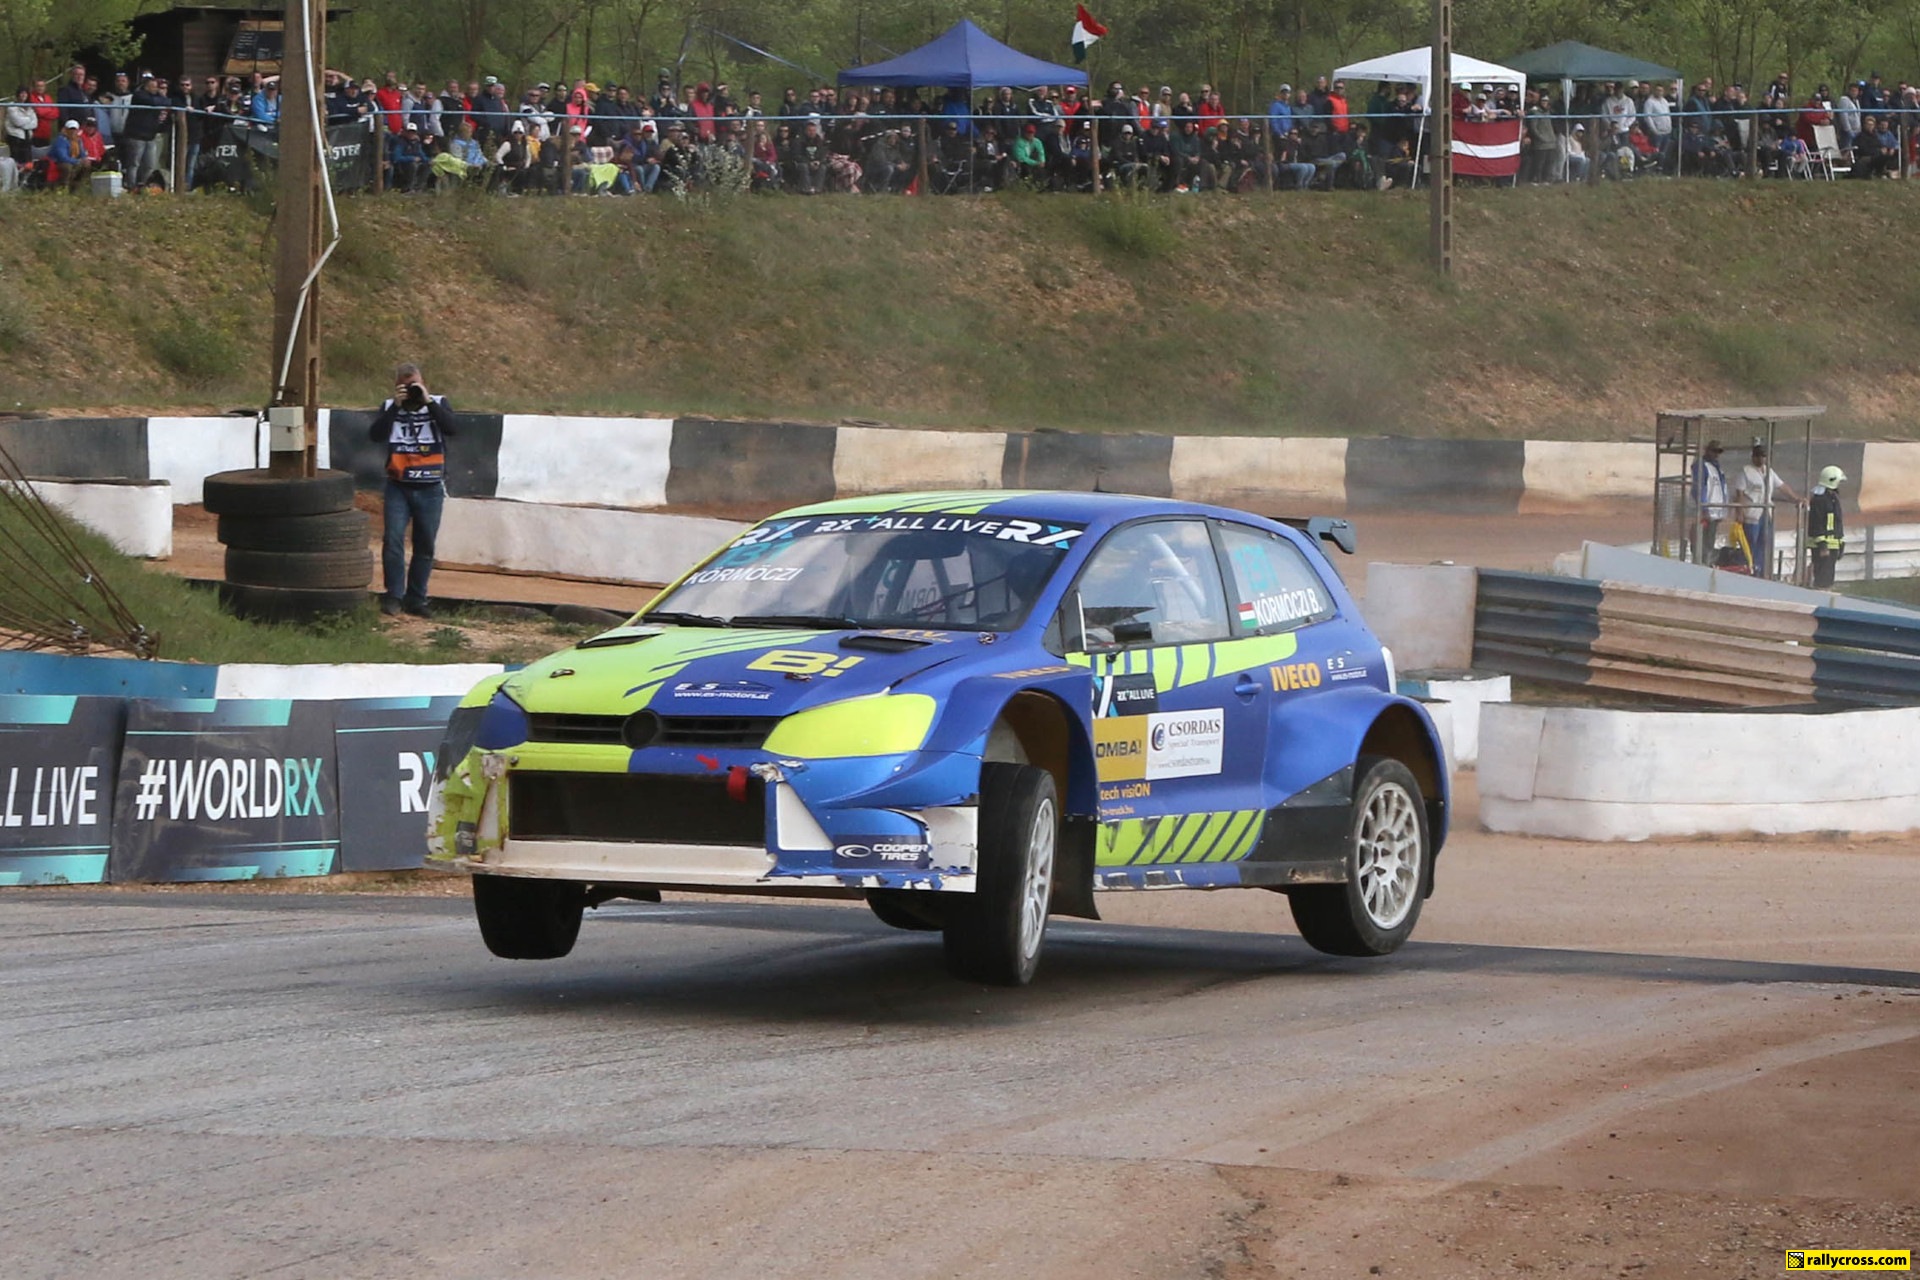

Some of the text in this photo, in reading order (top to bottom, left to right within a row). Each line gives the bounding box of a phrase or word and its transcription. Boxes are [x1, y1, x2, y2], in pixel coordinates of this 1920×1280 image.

[931, 518, 1002, 534] LIVE
[996, 520, 1084, 549] RX
[746, 650, 865, 677] B!
[1270, 662, 1322, 692] IVECO
[1168, 719, 1221, 737] CSORDAS
[30, 765, 99, 827] LIVE
[136, 757, 324, 821] #WORLDRX
[872, 843, 929, 852] COOPER
[879, 852, 920, 861] TIRES
